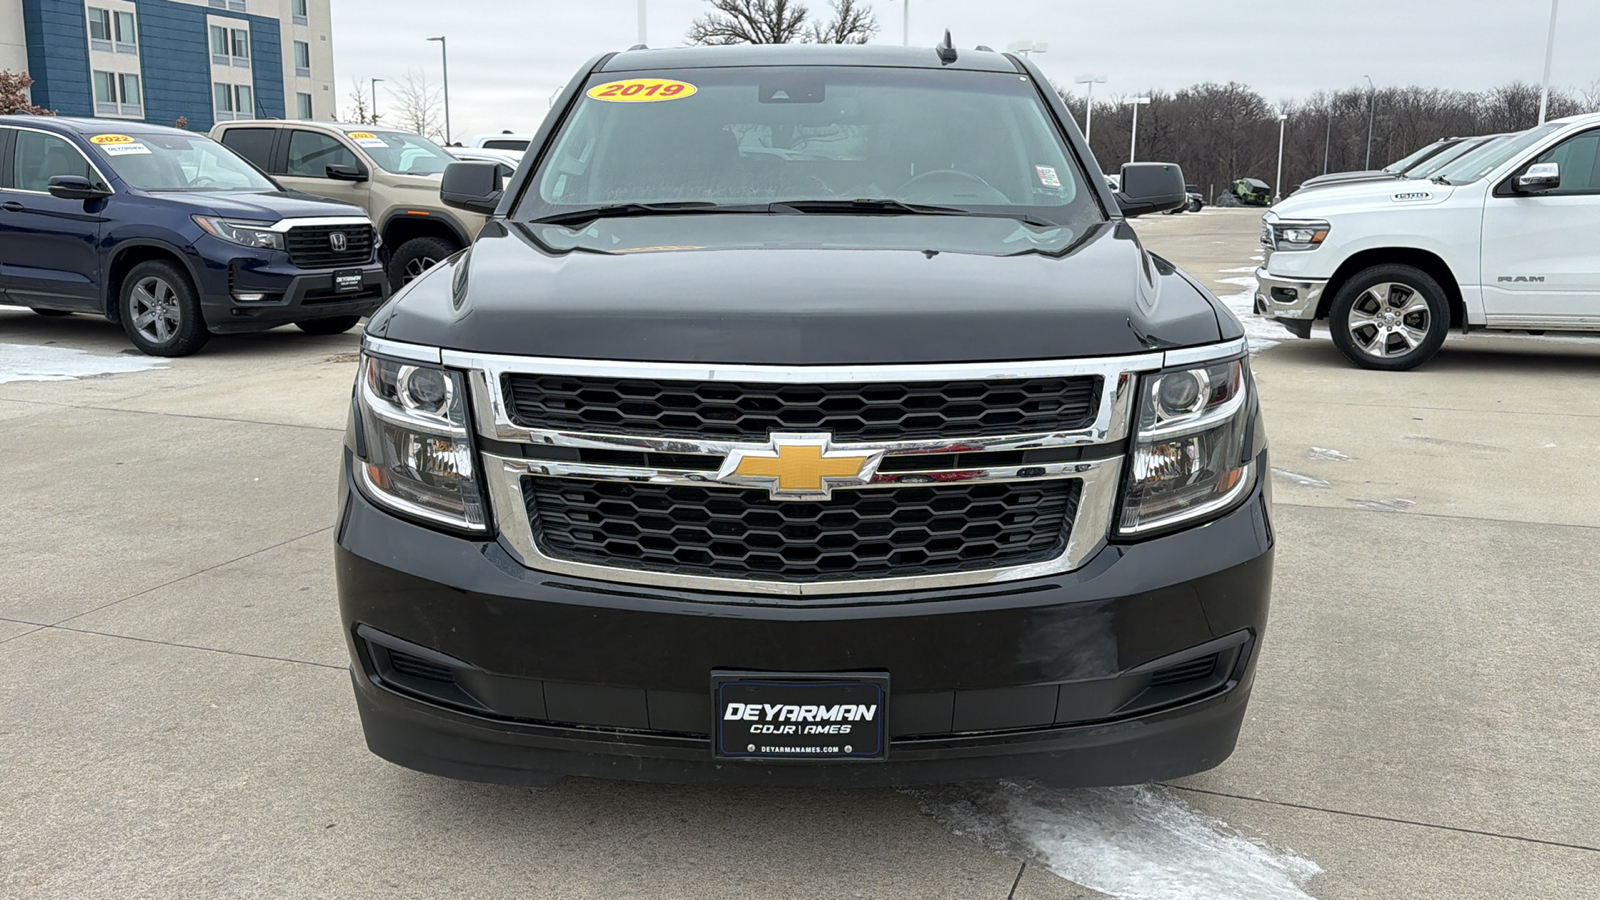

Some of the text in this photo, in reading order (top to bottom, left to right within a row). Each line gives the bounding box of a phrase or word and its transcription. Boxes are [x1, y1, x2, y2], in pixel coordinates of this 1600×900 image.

[597, 84, 685, 97] 2019
[723, 702, 877, 722] DEYARMAN
[750, 724, 852, 734] CDJR AMES
